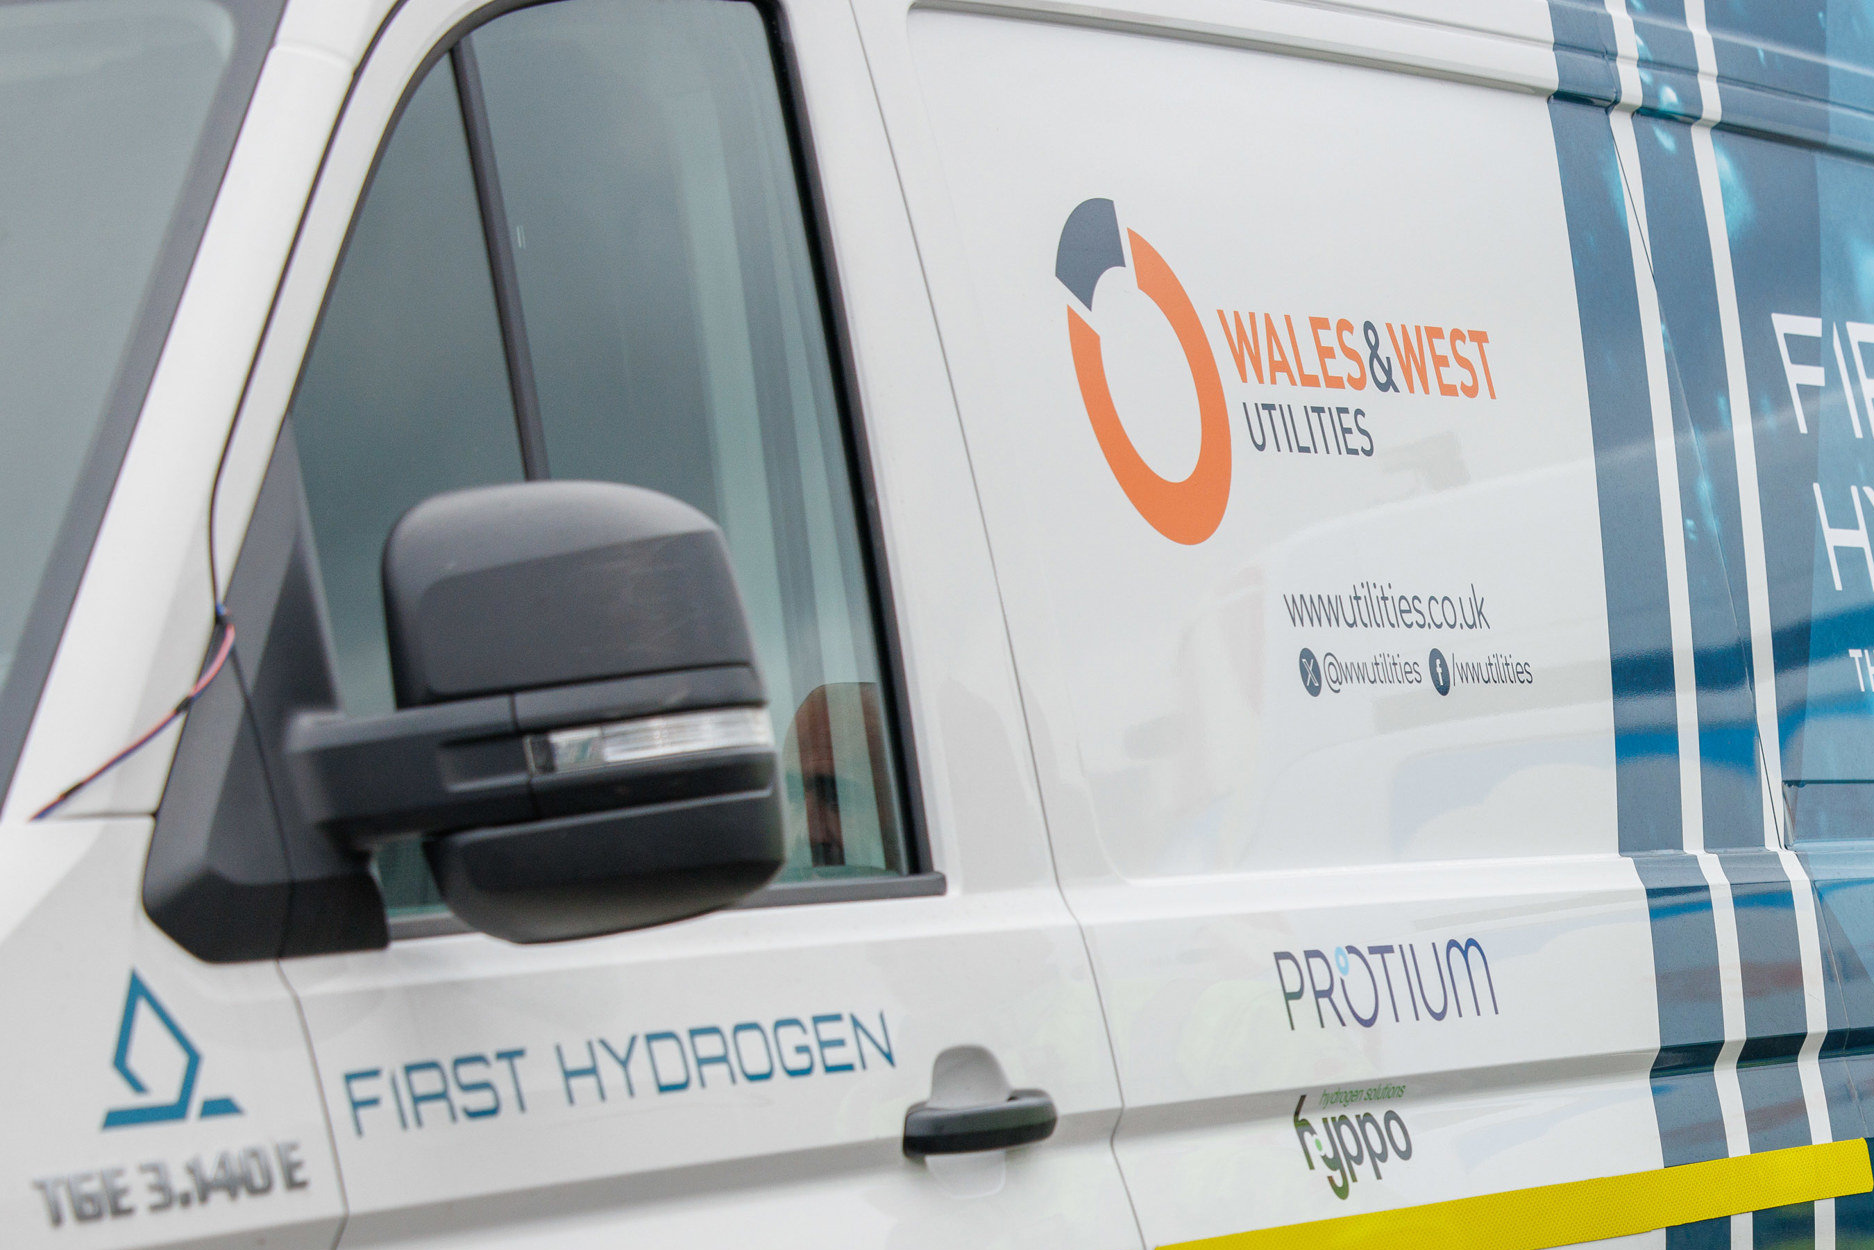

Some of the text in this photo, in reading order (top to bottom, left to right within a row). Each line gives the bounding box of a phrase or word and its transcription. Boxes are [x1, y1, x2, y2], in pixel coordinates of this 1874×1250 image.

[1216, 308, 1497, 399] WALES&WEST
[1243, 402, 1374, 457] UTILITIES
[1323, 652, 1422, 694] @wwutilities
[1273, 937, 1500, 1031] PROTIUM
[343, 1010, 898, 1138] FIRST HYDROGEN
[1320, 1082, 1407, 1110] hydrogen solutions
[32, 1165, 135, 1229] TGE
[276, 1141, 310, 1192] E
